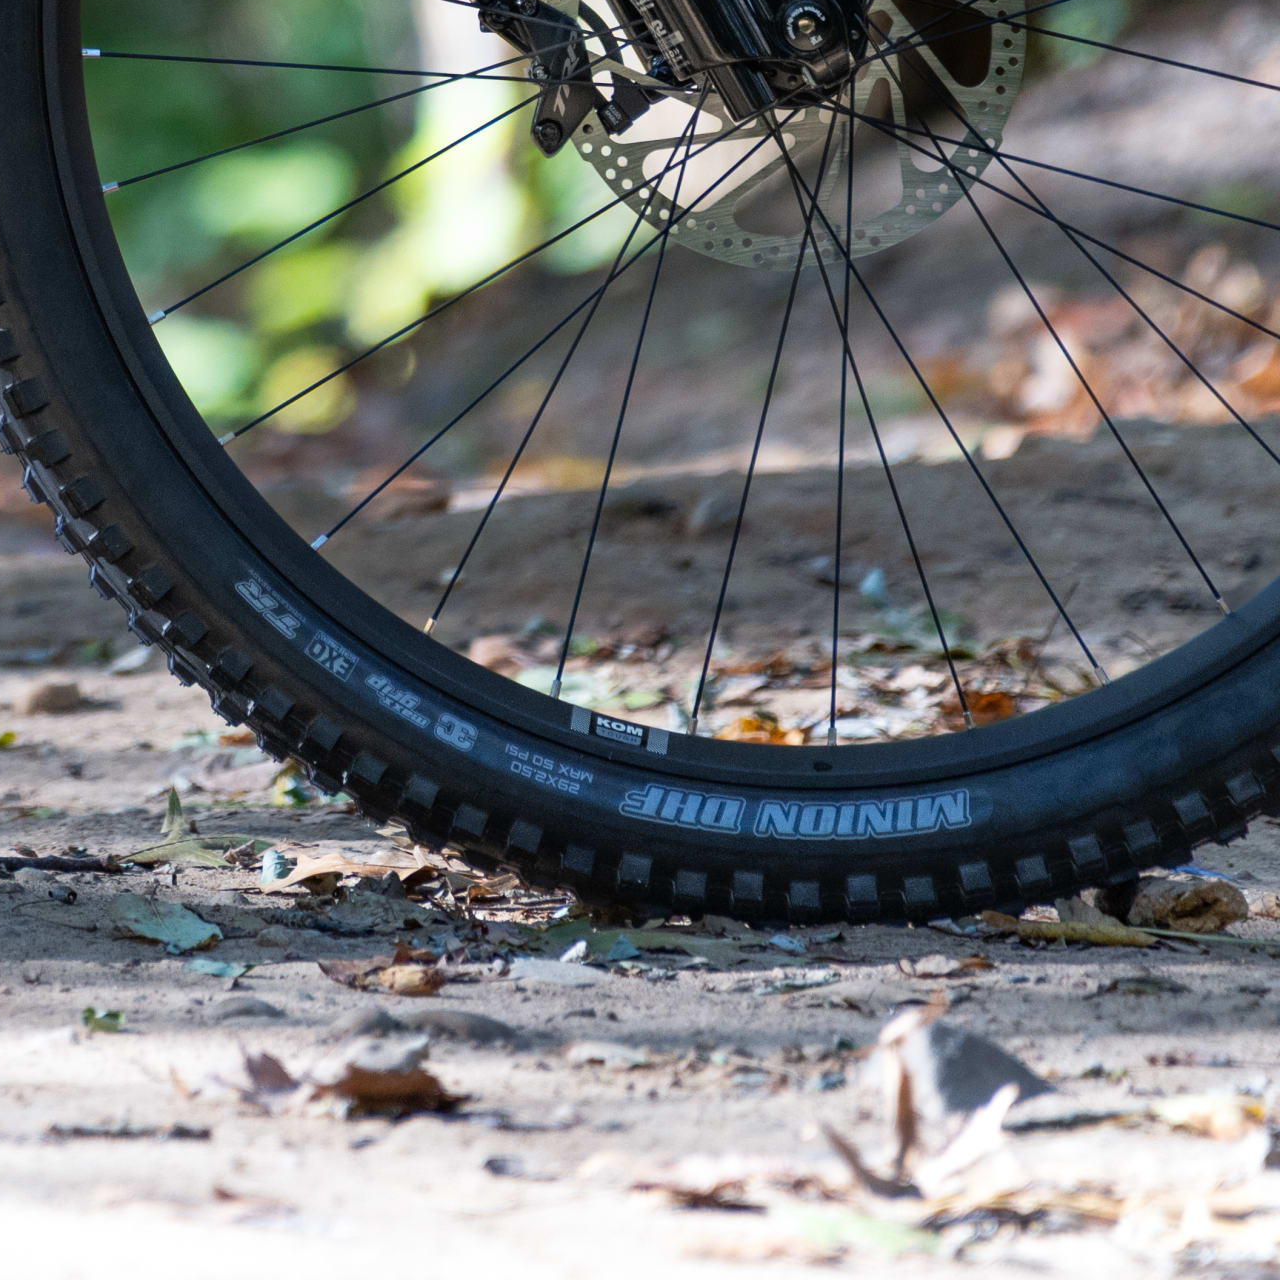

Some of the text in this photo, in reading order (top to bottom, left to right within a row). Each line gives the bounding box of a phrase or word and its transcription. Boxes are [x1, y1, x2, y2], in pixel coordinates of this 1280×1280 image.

[596, 716, 643, 737] KOM
[505, 743, 529, 761] PSI
[510, 760, 580, 795] 29X2.50
[558, 763, 594, 784] MAX
[619, 784, 972, 839] MINION DHF
